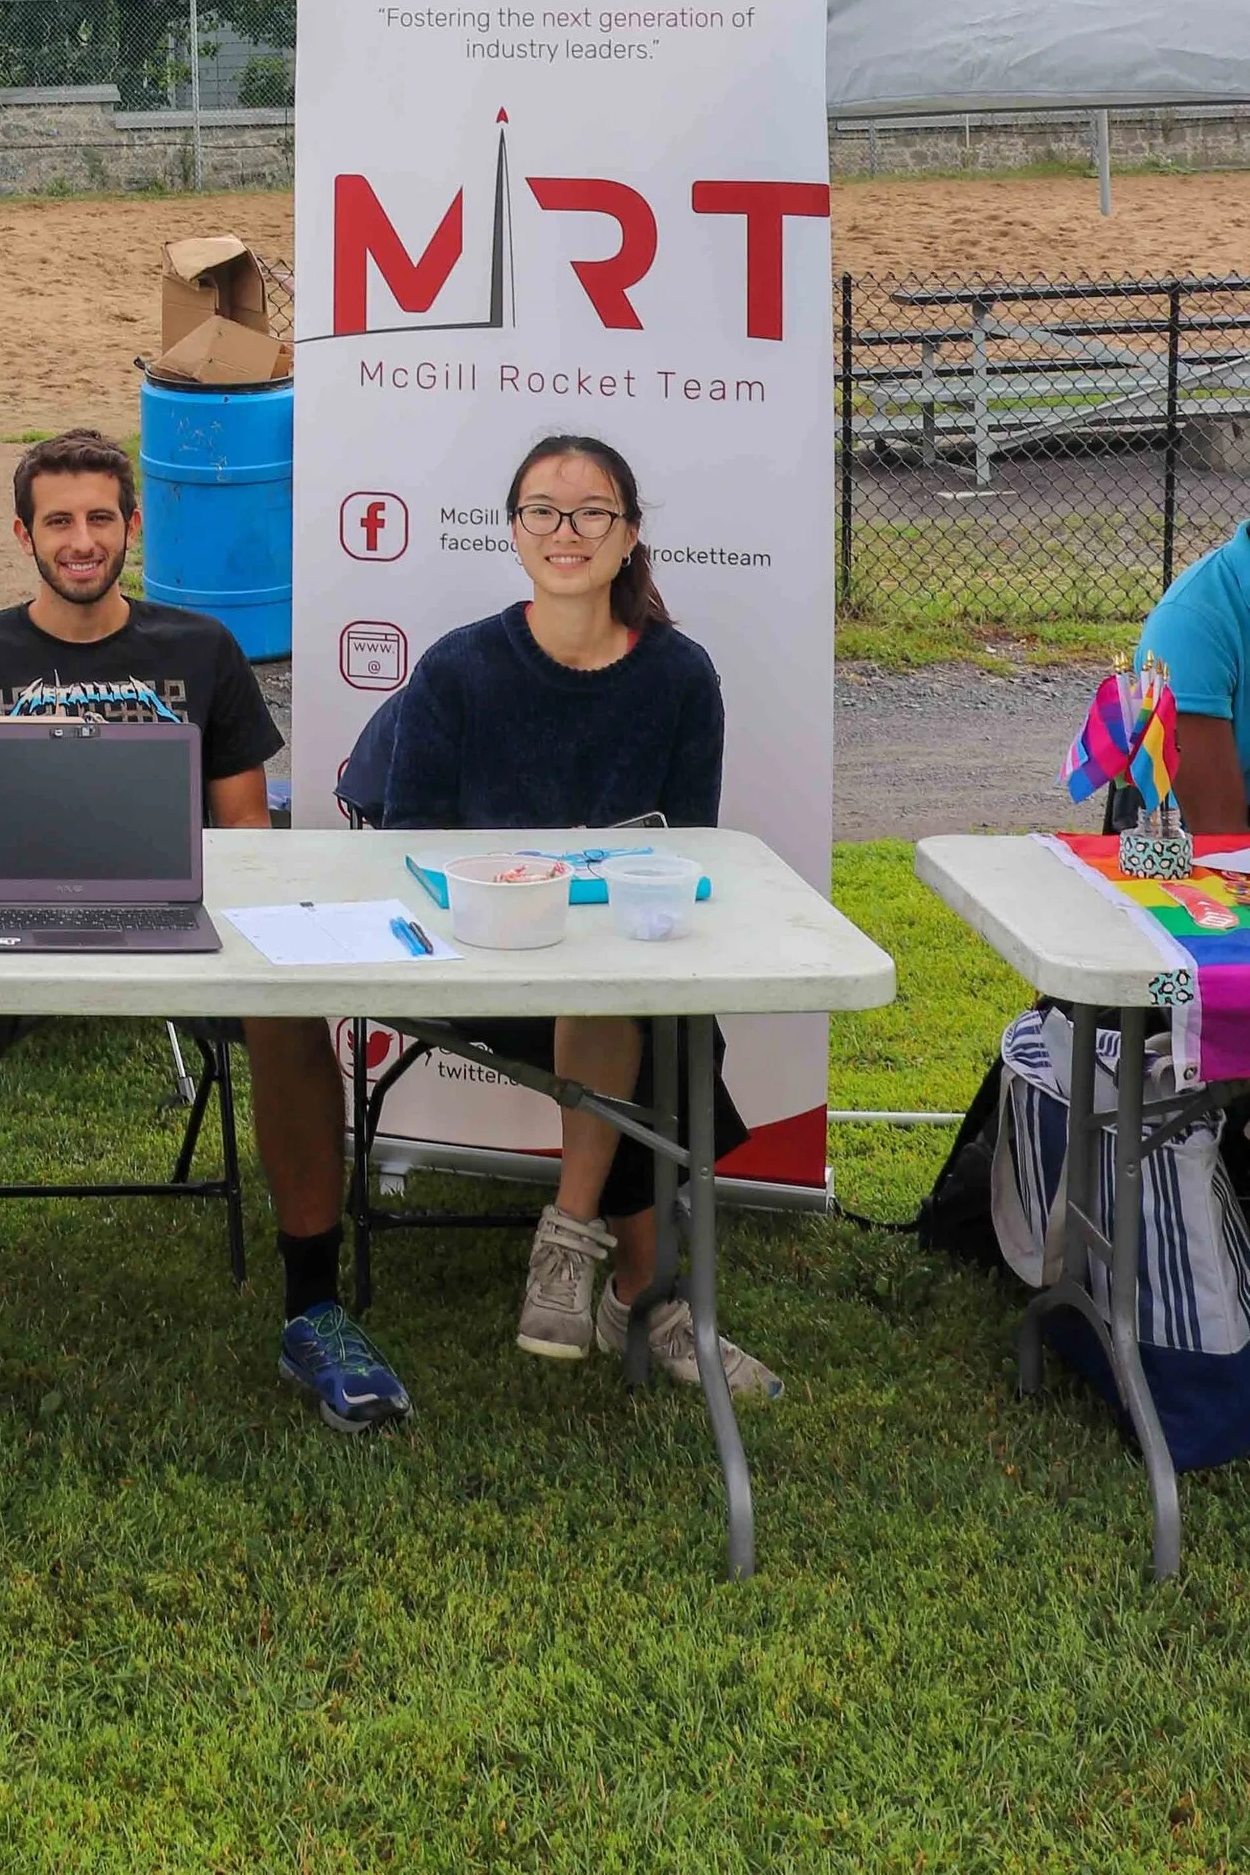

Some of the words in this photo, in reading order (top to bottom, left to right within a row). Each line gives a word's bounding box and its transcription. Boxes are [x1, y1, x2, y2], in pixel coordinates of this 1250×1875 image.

[497, 7, 535, 29] the
[542, 7, 592, 29] next
[598, 7, 724, 35] generation
[731, 6, 756, 29] of
[466, 38, 559, 63] industry
[333, 173, 831, 341] MRT
[360, 360, 476, 392] McGill
[500, 364, 636, 398] Rocket
[656, 370, 765, 403] Team
[440, 507, 499, 526] McGill
[9, 668, 182, 724] METALLICA
